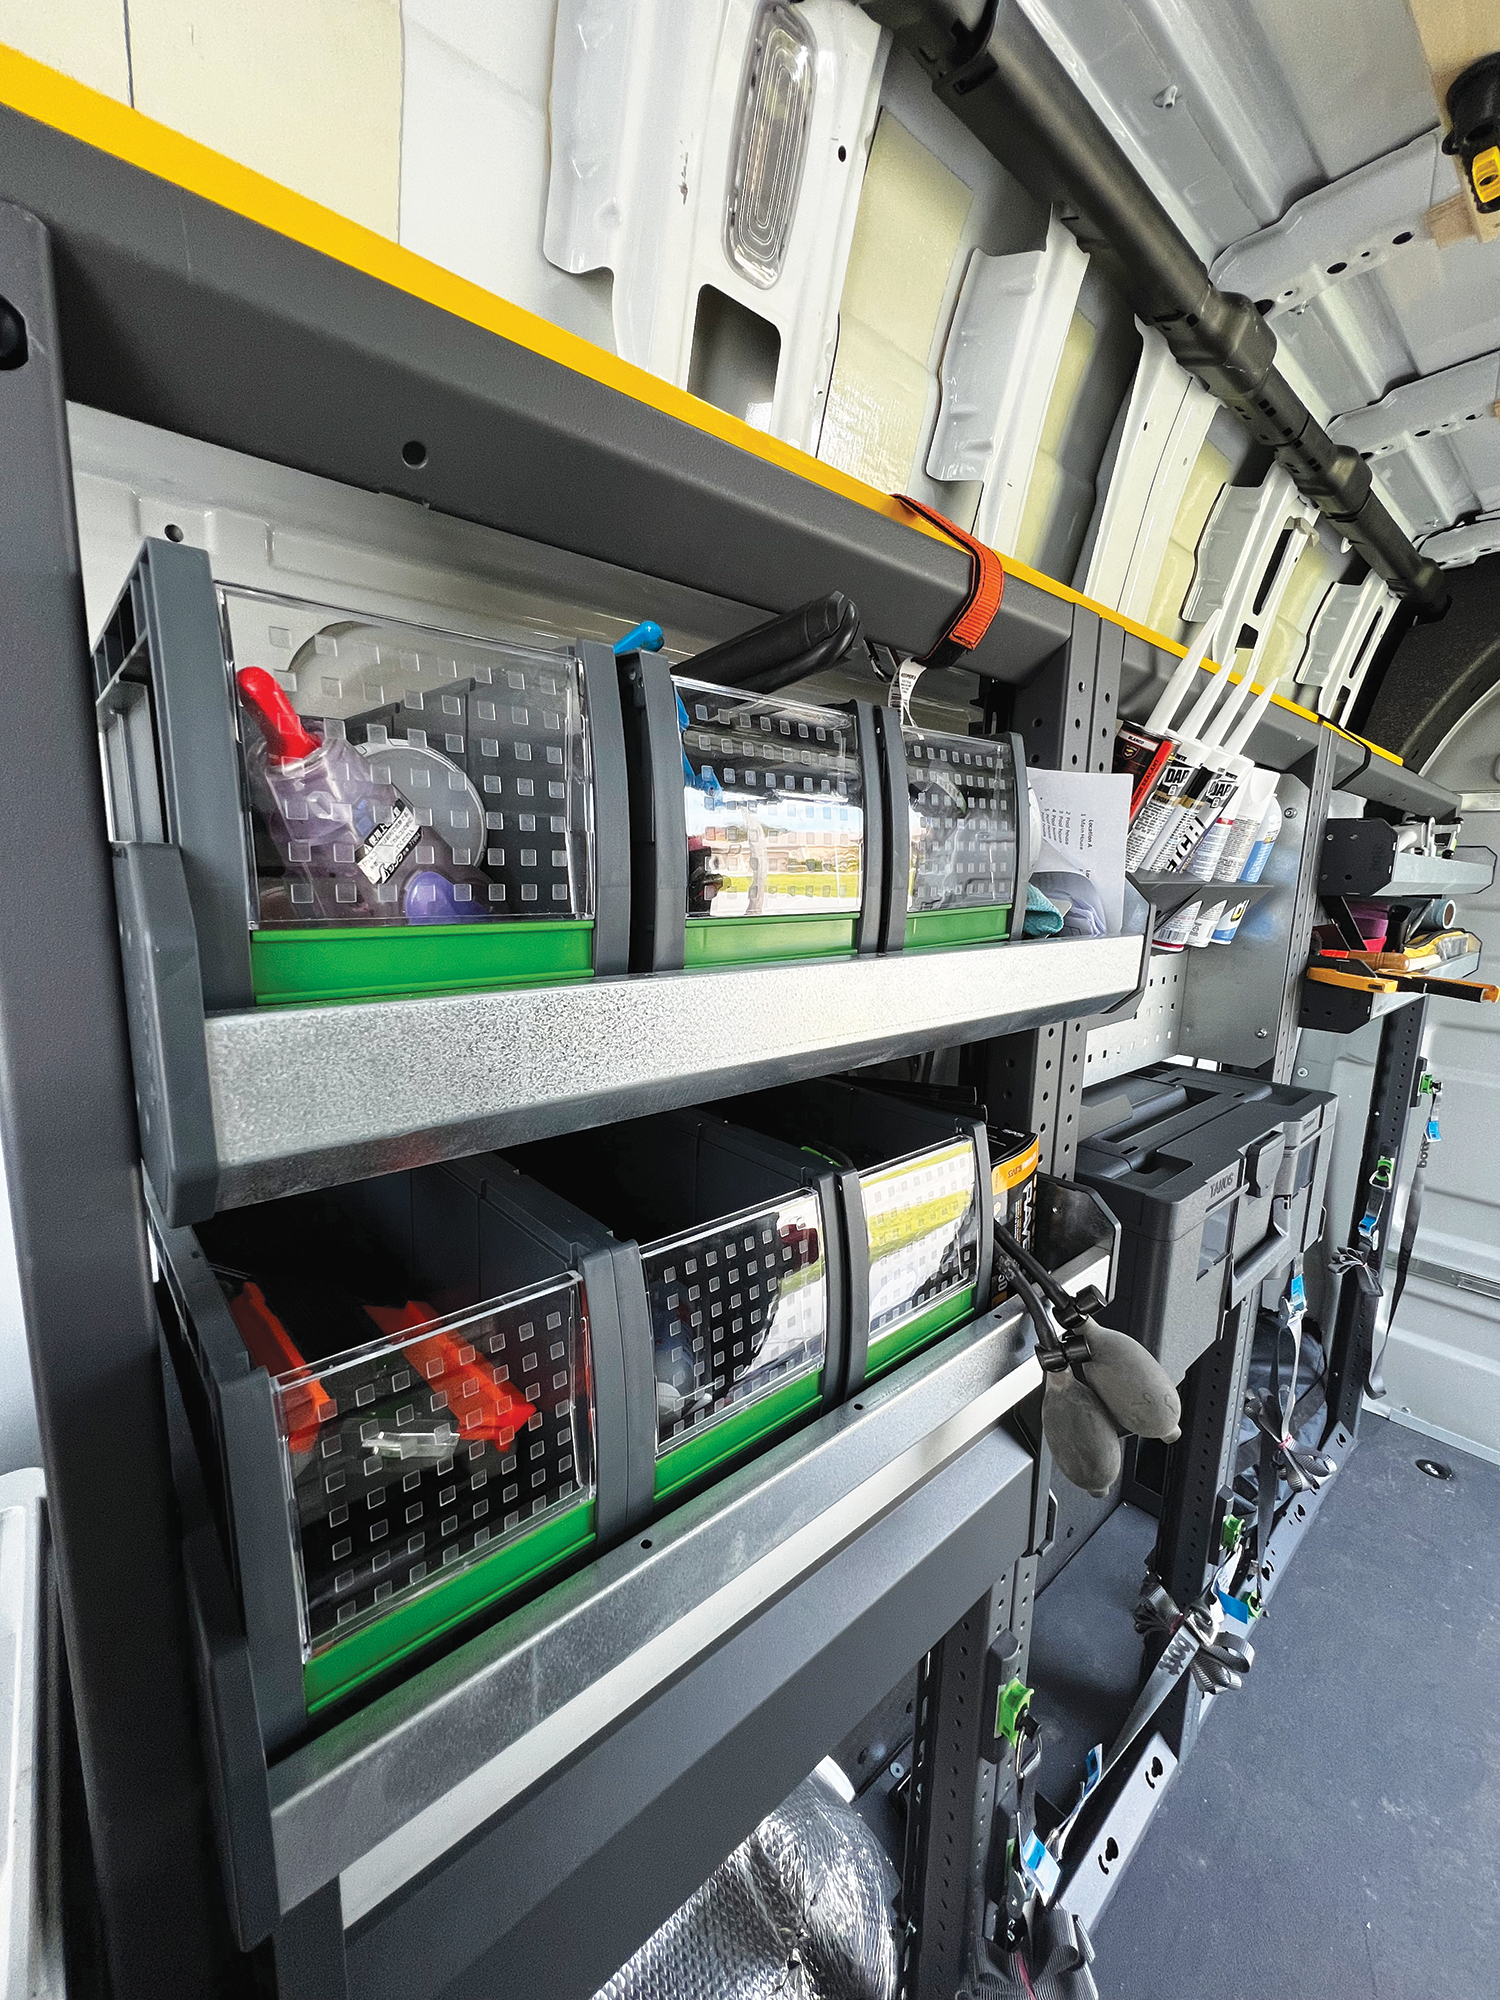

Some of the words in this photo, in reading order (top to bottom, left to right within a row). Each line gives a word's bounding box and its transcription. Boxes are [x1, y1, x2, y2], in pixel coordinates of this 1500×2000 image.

[1127, 735, 1145, 745] BLANCO
[1141, 760, 1159, 787] SEALANT
[1165, 768, 1190, 784] DAP
[1210, 1172, 1234, 1198] TANOS
[1021, 1180, 1033, 1251] RAVE
[1157, 1632, 1196, 1675] bott
